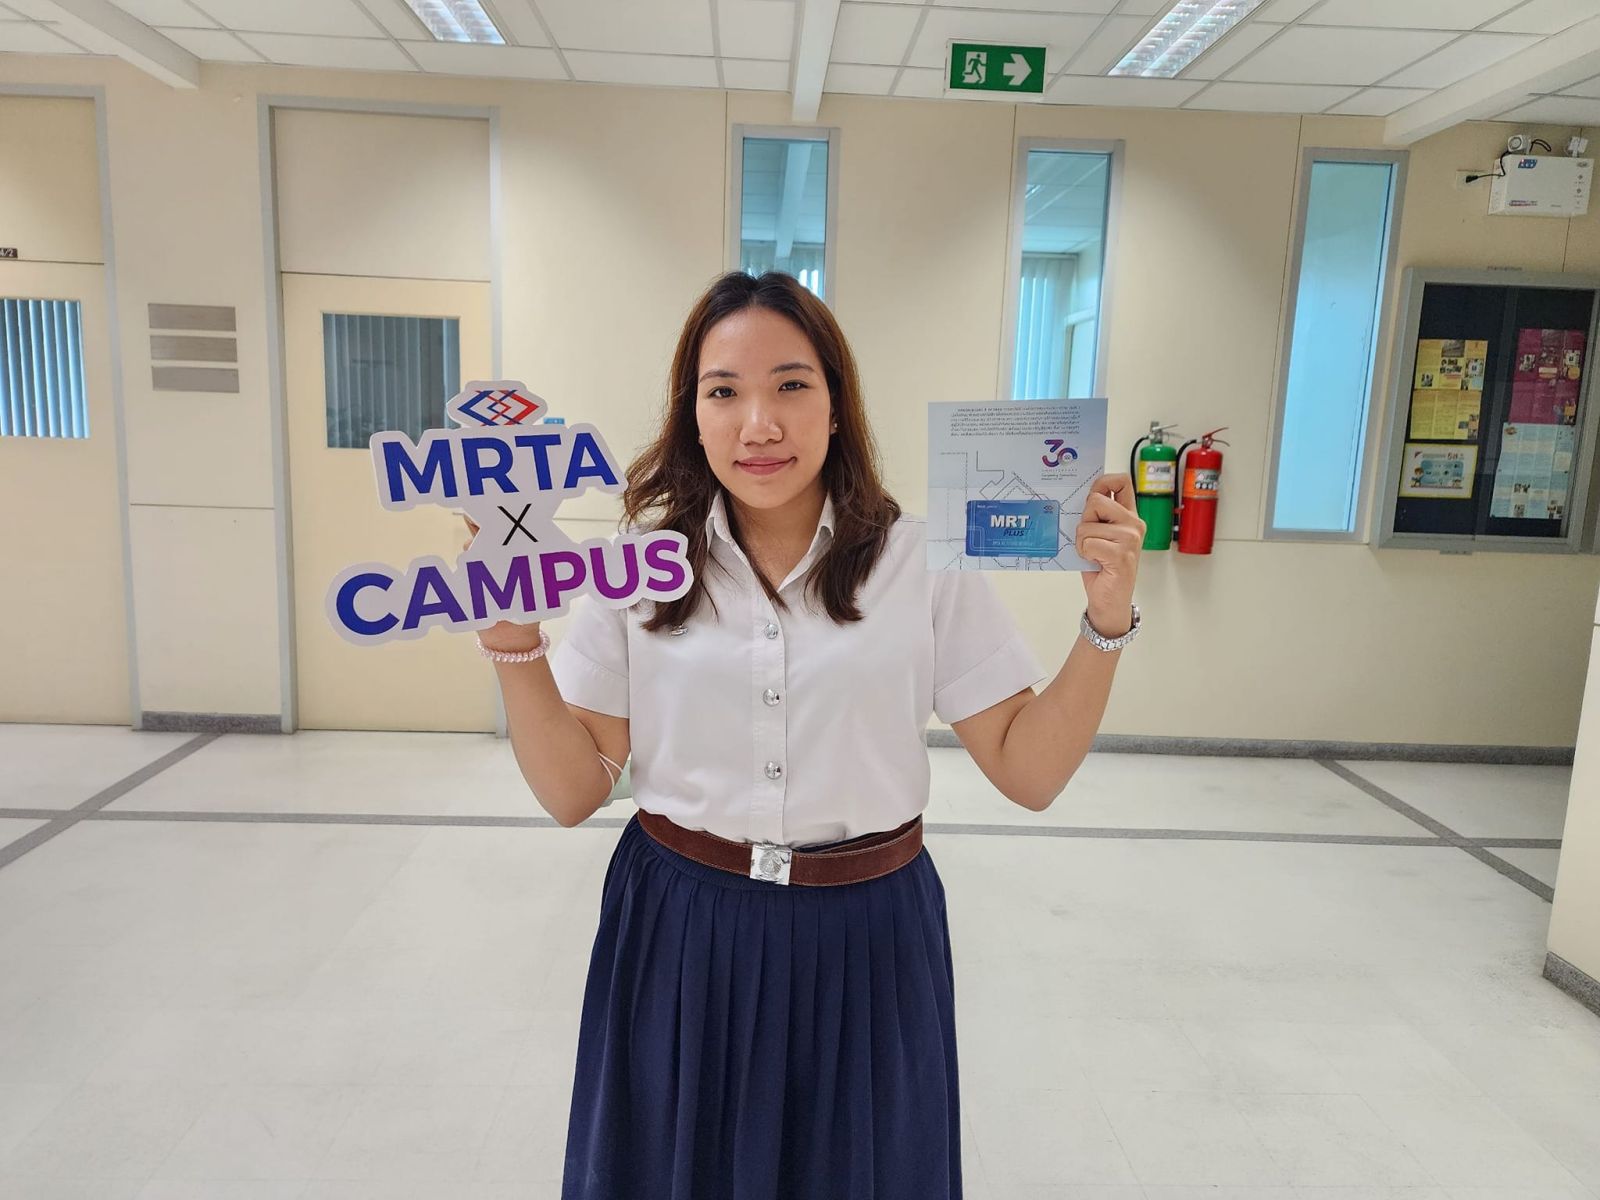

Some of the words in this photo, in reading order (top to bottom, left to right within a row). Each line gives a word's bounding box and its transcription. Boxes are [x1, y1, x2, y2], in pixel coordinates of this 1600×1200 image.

[382, 432, 619, 502] MRTA
[1042, 439, 1078, 467] 30
[990, 514, 1030, 528] MRT
[1003, 529, 1025, 537] PLUS
[336, 539, 686, 636] CAMPUS
